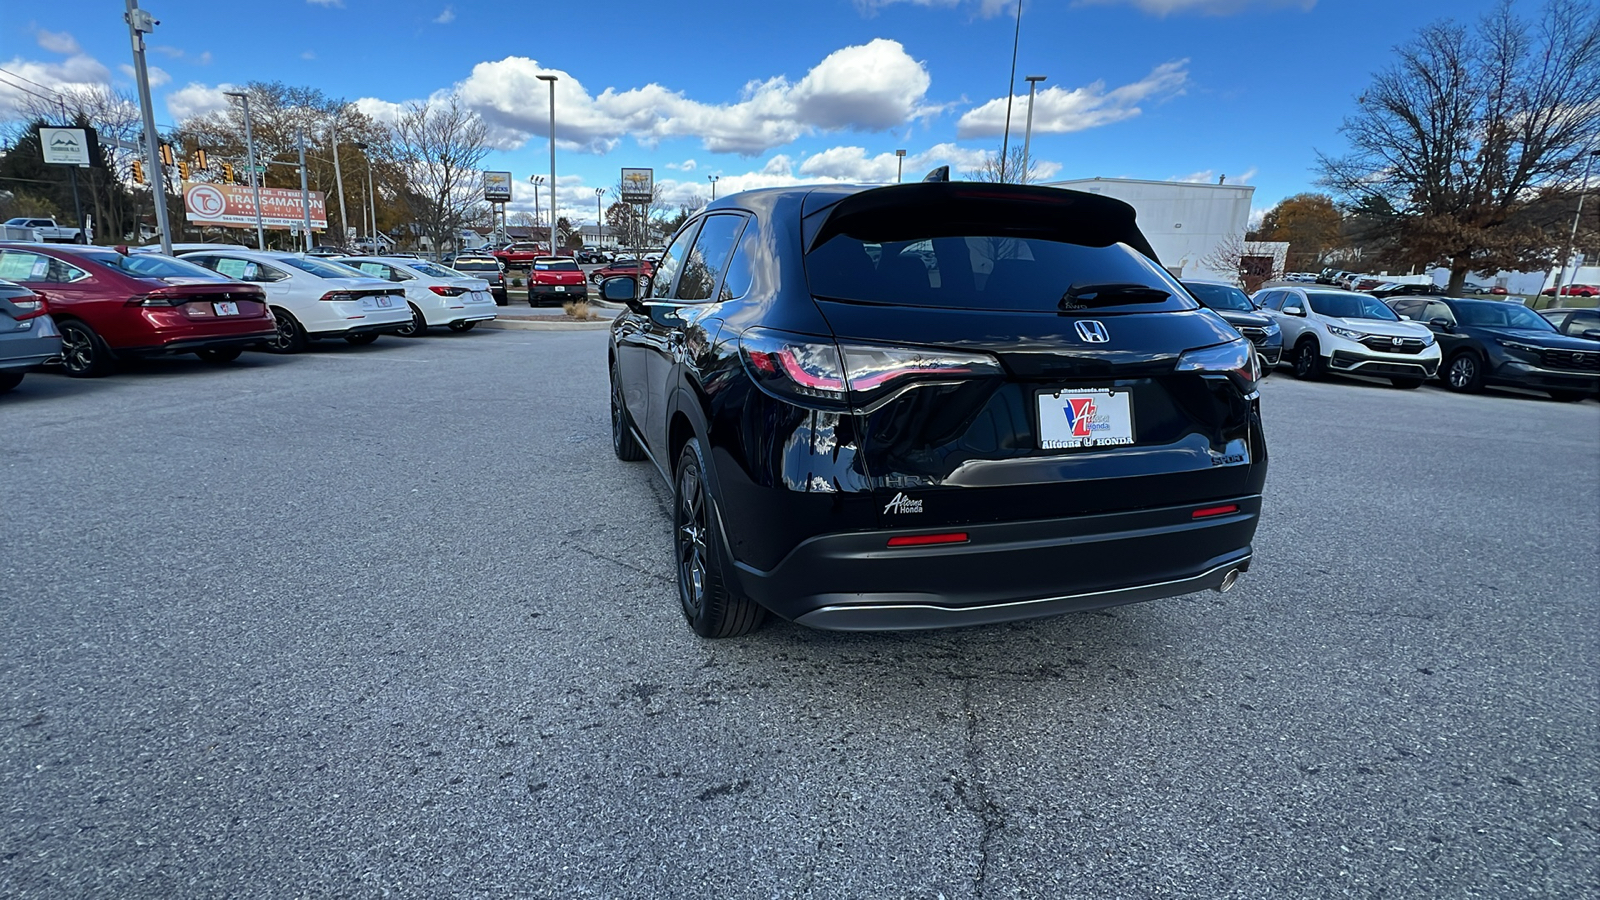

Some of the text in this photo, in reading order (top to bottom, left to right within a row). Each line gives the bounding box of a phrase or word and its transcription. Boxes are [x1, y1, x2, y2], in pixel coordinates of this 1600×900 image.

[227, 194, 323, 209] TRANS4MATION
[1087, 423, 1111, 431] Honda
[1042, 440, 1081, 449] Altoona
[1097, 437, 1135, 447] HONDA
[900, 506, 923, 514] Honda
